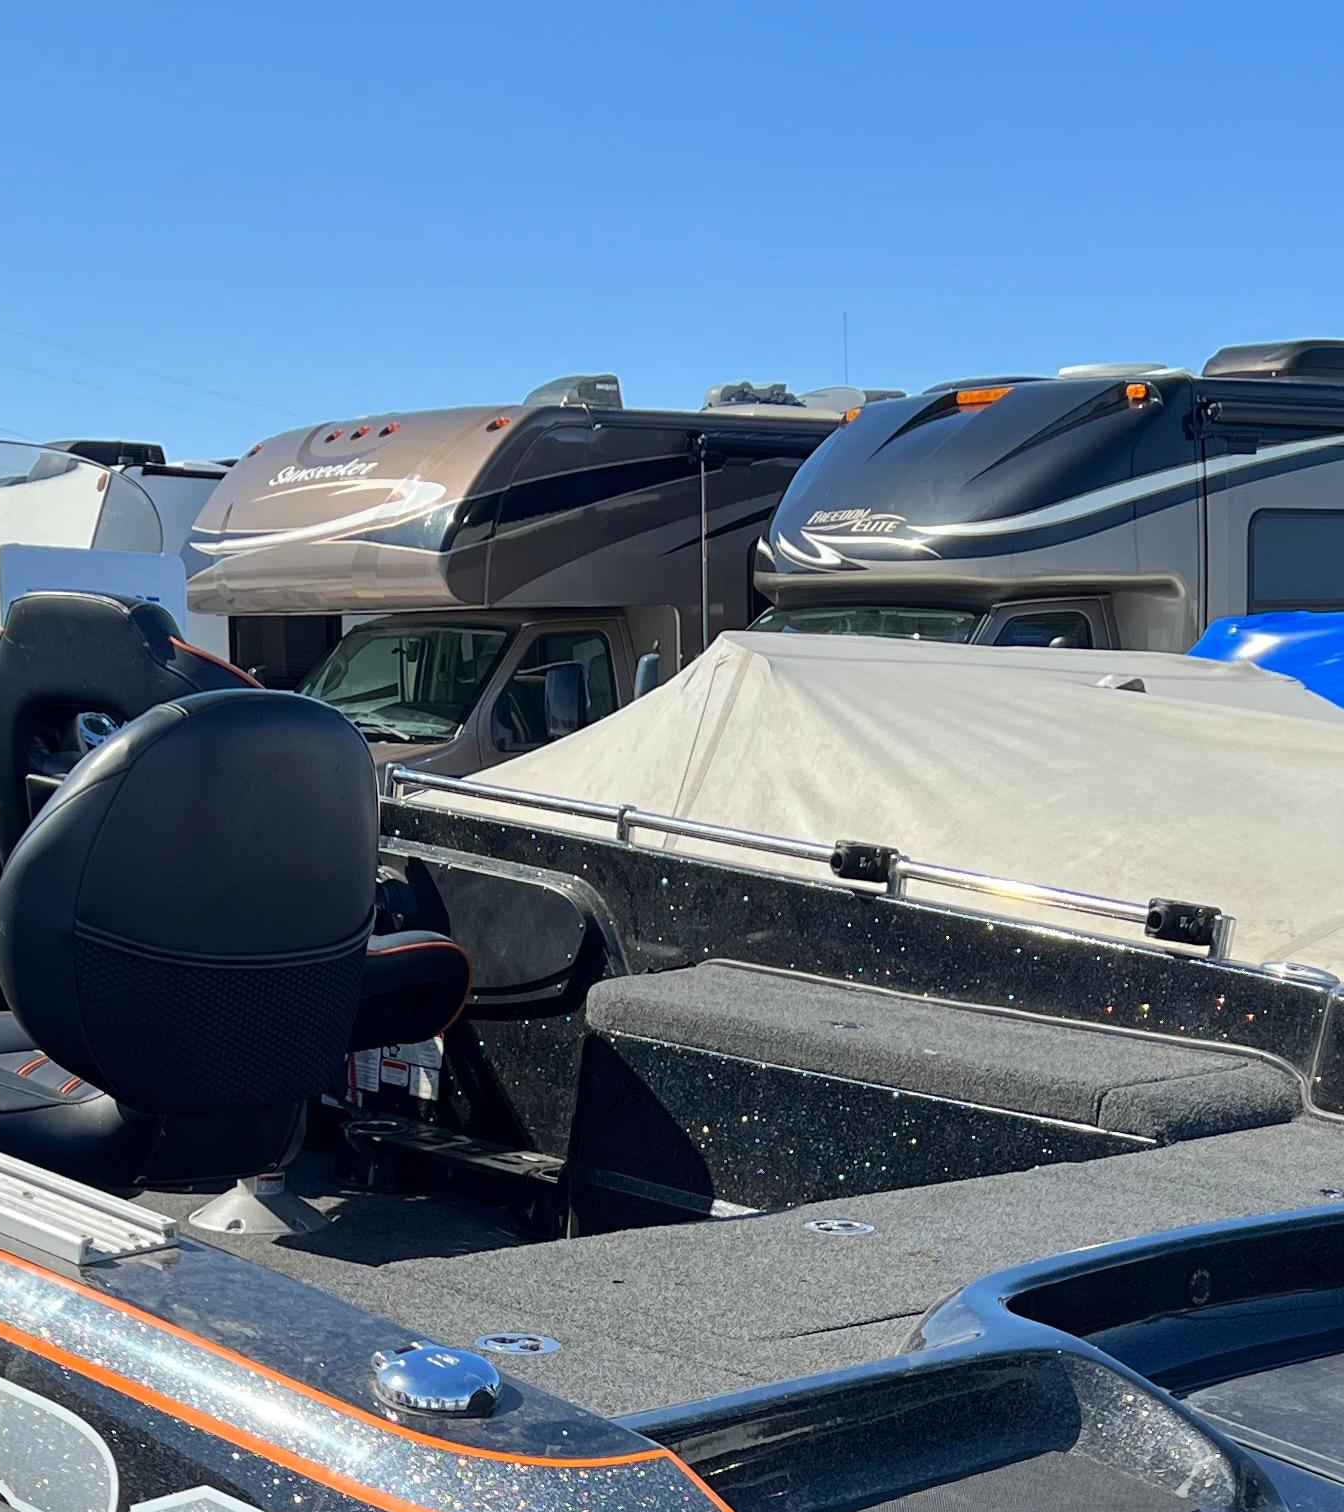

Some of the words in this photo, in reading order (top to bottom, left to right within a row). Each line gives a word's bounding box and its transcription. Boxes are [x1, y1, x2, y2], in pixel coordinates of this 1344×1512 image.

[268, 458, 379, 487] Sunseeker
[806, 507, 872, 526] FREEDOM
[850, 519, 901, 533] ELITE
